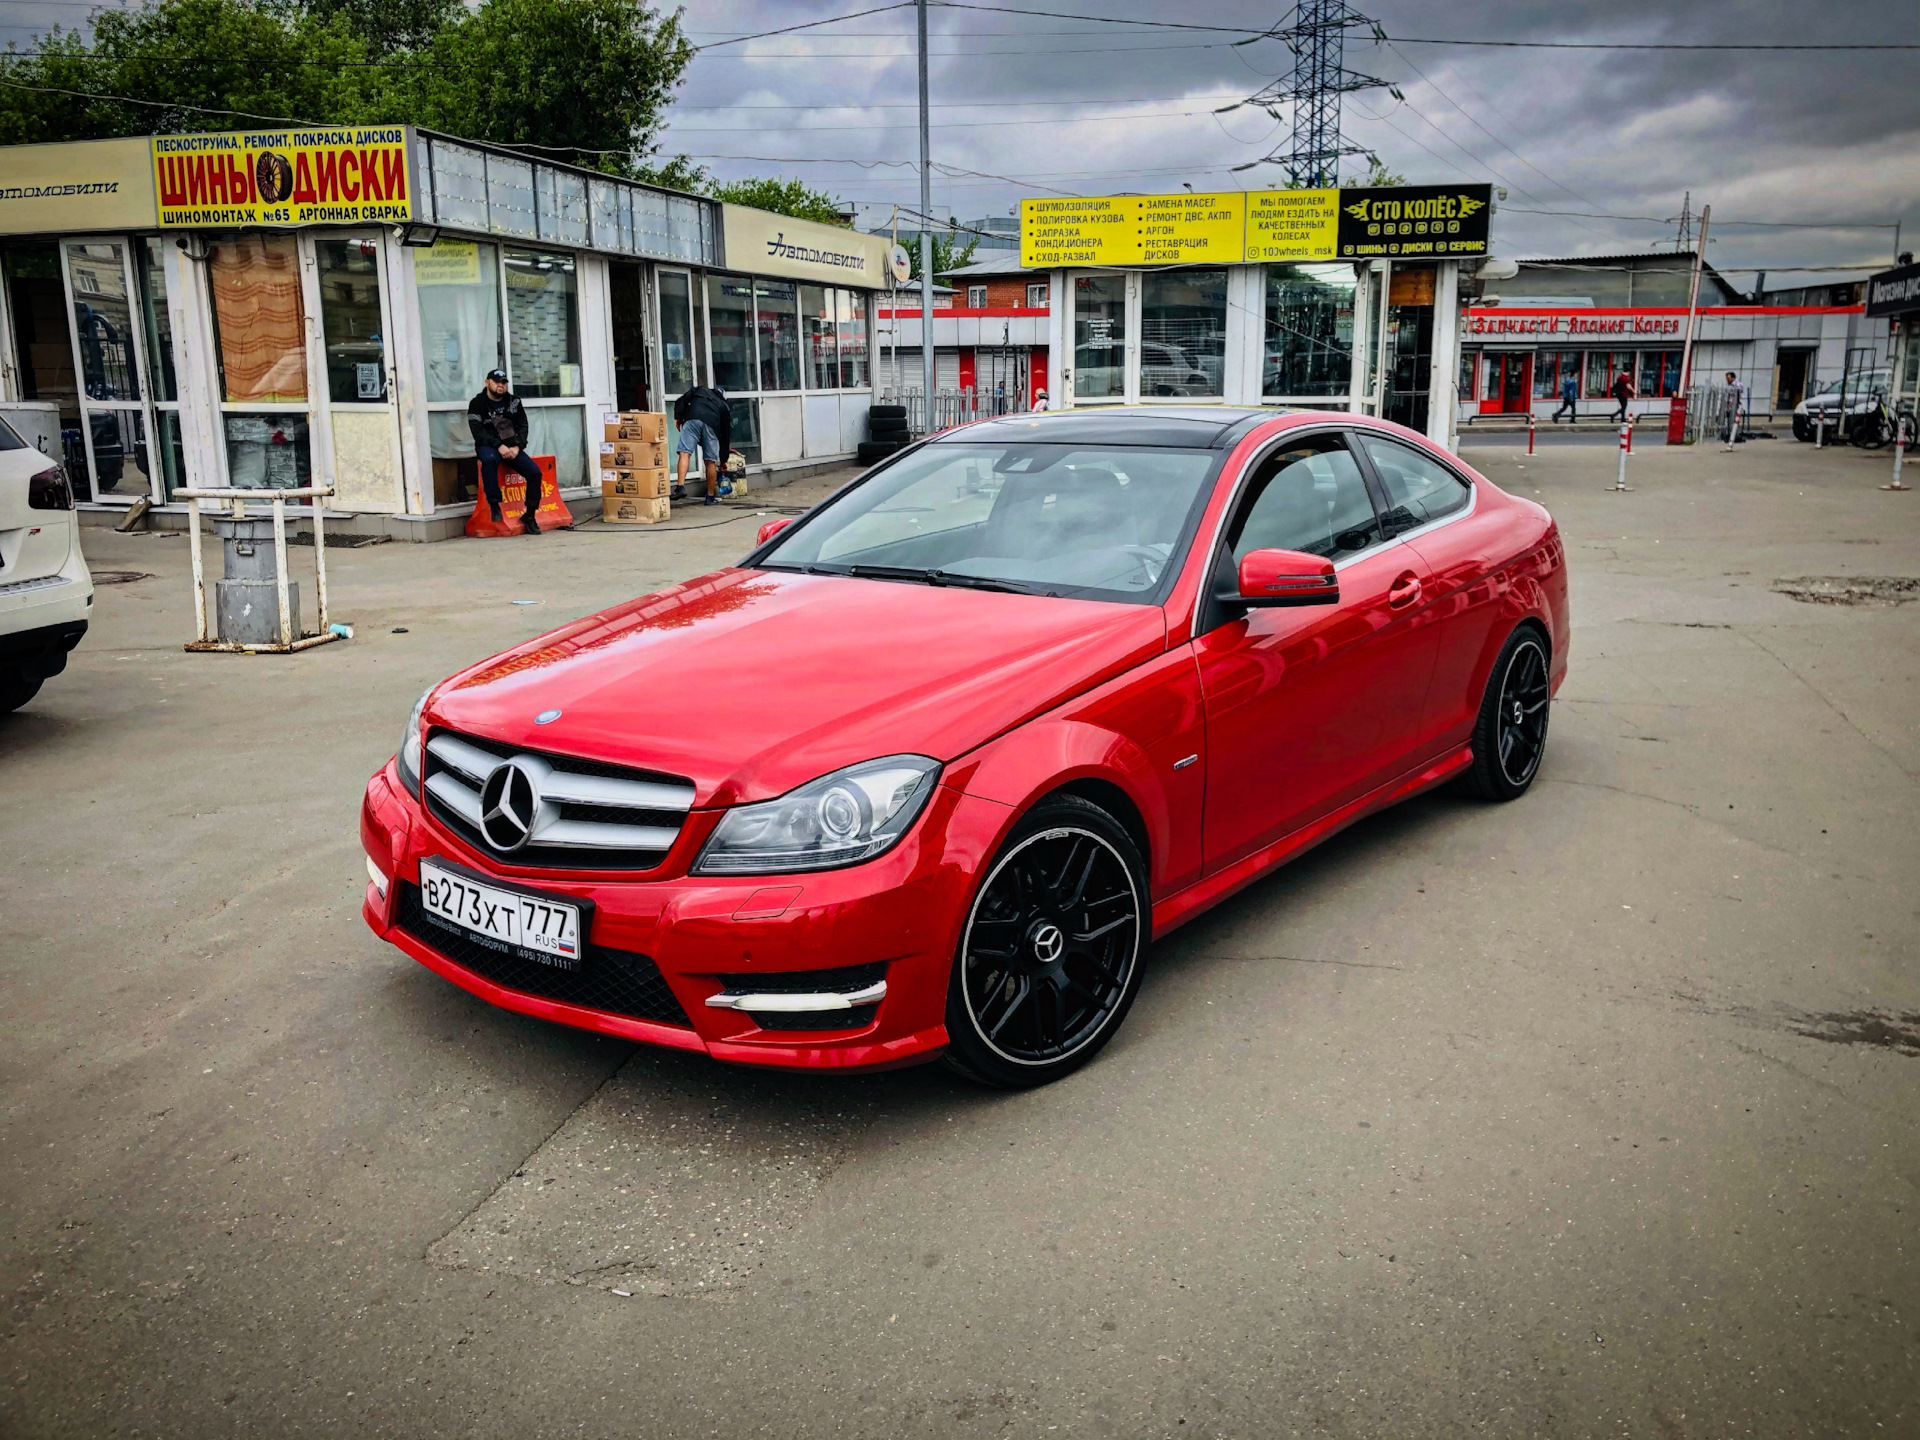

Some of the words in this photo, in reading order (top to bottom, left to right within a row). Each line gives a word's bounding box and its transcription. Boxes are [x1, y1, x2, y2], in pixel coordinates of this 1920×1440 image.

[156, 135, 242, 152] ПЕСКОСТРУЙКА,
[244, 134, 291, 149] РЕМОНТ,
[294, 132, 353, 146] ПОКРАСКА
[356, 130, 402, 146] ДИСКОВ
[158, 153, 257, 206] ШИНЫ
[293, 149, 405, 205] ДИСКИ
[1036, 201, 1110, 212] ШУМОИЗОЛЯЦИЯ
[1147, 199, 1182, 209] ЗАМЕНА
[1185, 198, 1215, 208] МАСЕЛ
[1260, 198, 1275, 206] МЫ
[1278, 197, 1325, 206] ПОМОГАЕМ
[1372, 201, 1400, 220] СТО
[1404, 195, 1456, 219] КОЛЁС
[163, 209, 257, 223] ШИНОМОНТАЖ
[299, 207, 358, 220] АРГОННАЯ
[362, 206, 408, 219] СВАРКА
[1036, 215, 1088, 225] ПОЛИРОВКА
[1090, 214, 1124, 223] КУЗОВА
[1146, 212, 1182, 222] РЕМОНТ
[1185, 211, 1205, 222] ДВС,
[1208, 211, 1231, 220] АКПП
[1251, 210, 1284, 219] ЛЮДЯМ
[1287, 209, 1320, 219] ЕЗДИТЬ
[1323, 209, 1334, 217] НА
[1146, 226, 1174, 235] АРГОН
[1258, 221, 1325, 229] КАЧЕСТВЕННЫХ
[1037, 229, 1080, 237] ЗАПРАВКА
[1272, 232, 1310, 240] КОЛЕСАХ
[1035, 238, 1102, 248] КОНДИЦИОНЕРА
[1146, 238, 1208, 248] РЕСТАВРАЦИЯ
[1356, 244, 1386, 254] ШИНЫ
[1401, 242, 1432, 254] ДИСКИ
[1449, 241, 1485, 251] СЕРВИС
[1036, 252, 1095, 262] СХОД-РАЗВАЛ
[1144, 250, 1179, 260] ДИСКОВ
[535, 934, 557, 949] RUS
[517, 949, 535, 961] (495)
[537, 953, 551, 965] 730
[554, 957, 572, 971] 1111
